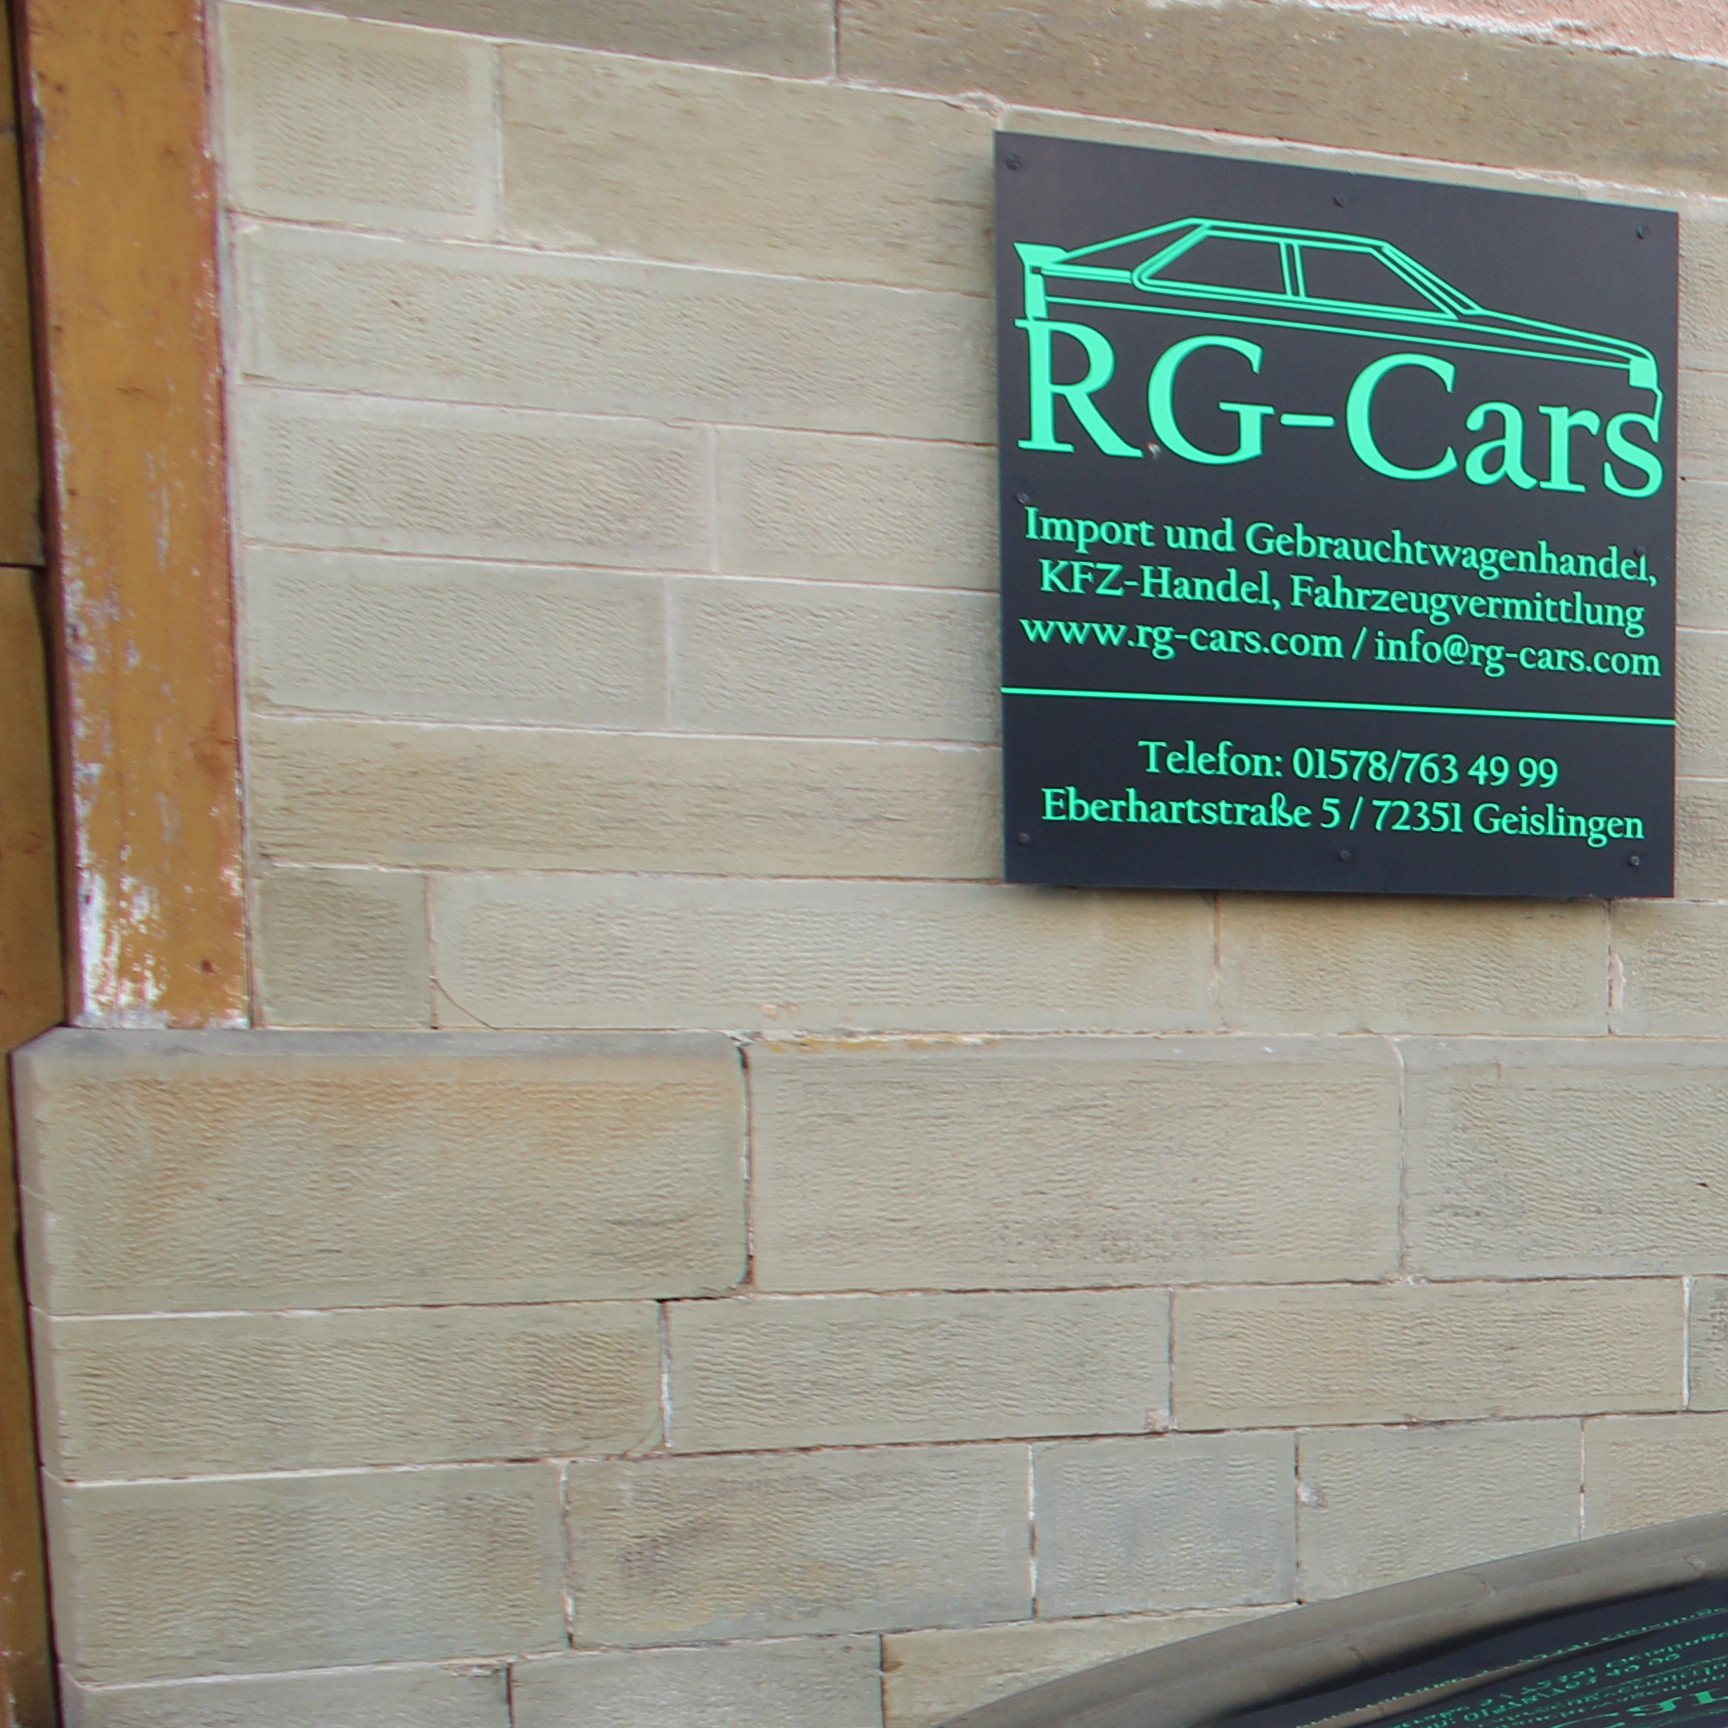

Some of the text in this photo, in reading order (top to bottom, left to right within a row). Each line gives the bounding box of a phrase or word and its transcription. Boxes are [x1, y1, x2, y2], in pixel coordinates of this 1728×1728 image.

[1014, 316, 1664, 499] RG-Cars
[1025, 507, 1659, 588] Import und Gebrauchtwagenhandel,
[1039, 559, 1647, 639] KFZ-Handel, Fahrzeugvermittlung
[1020, 619, 1663, 678] www.rg-cars.com / info@rg-cars.com
[1137, 740, 1561, 789] Telefon: 01578/763 49 99
[1041, 786, 1646, 848] Eberhartstraße 5 / 72351 Geislingen
